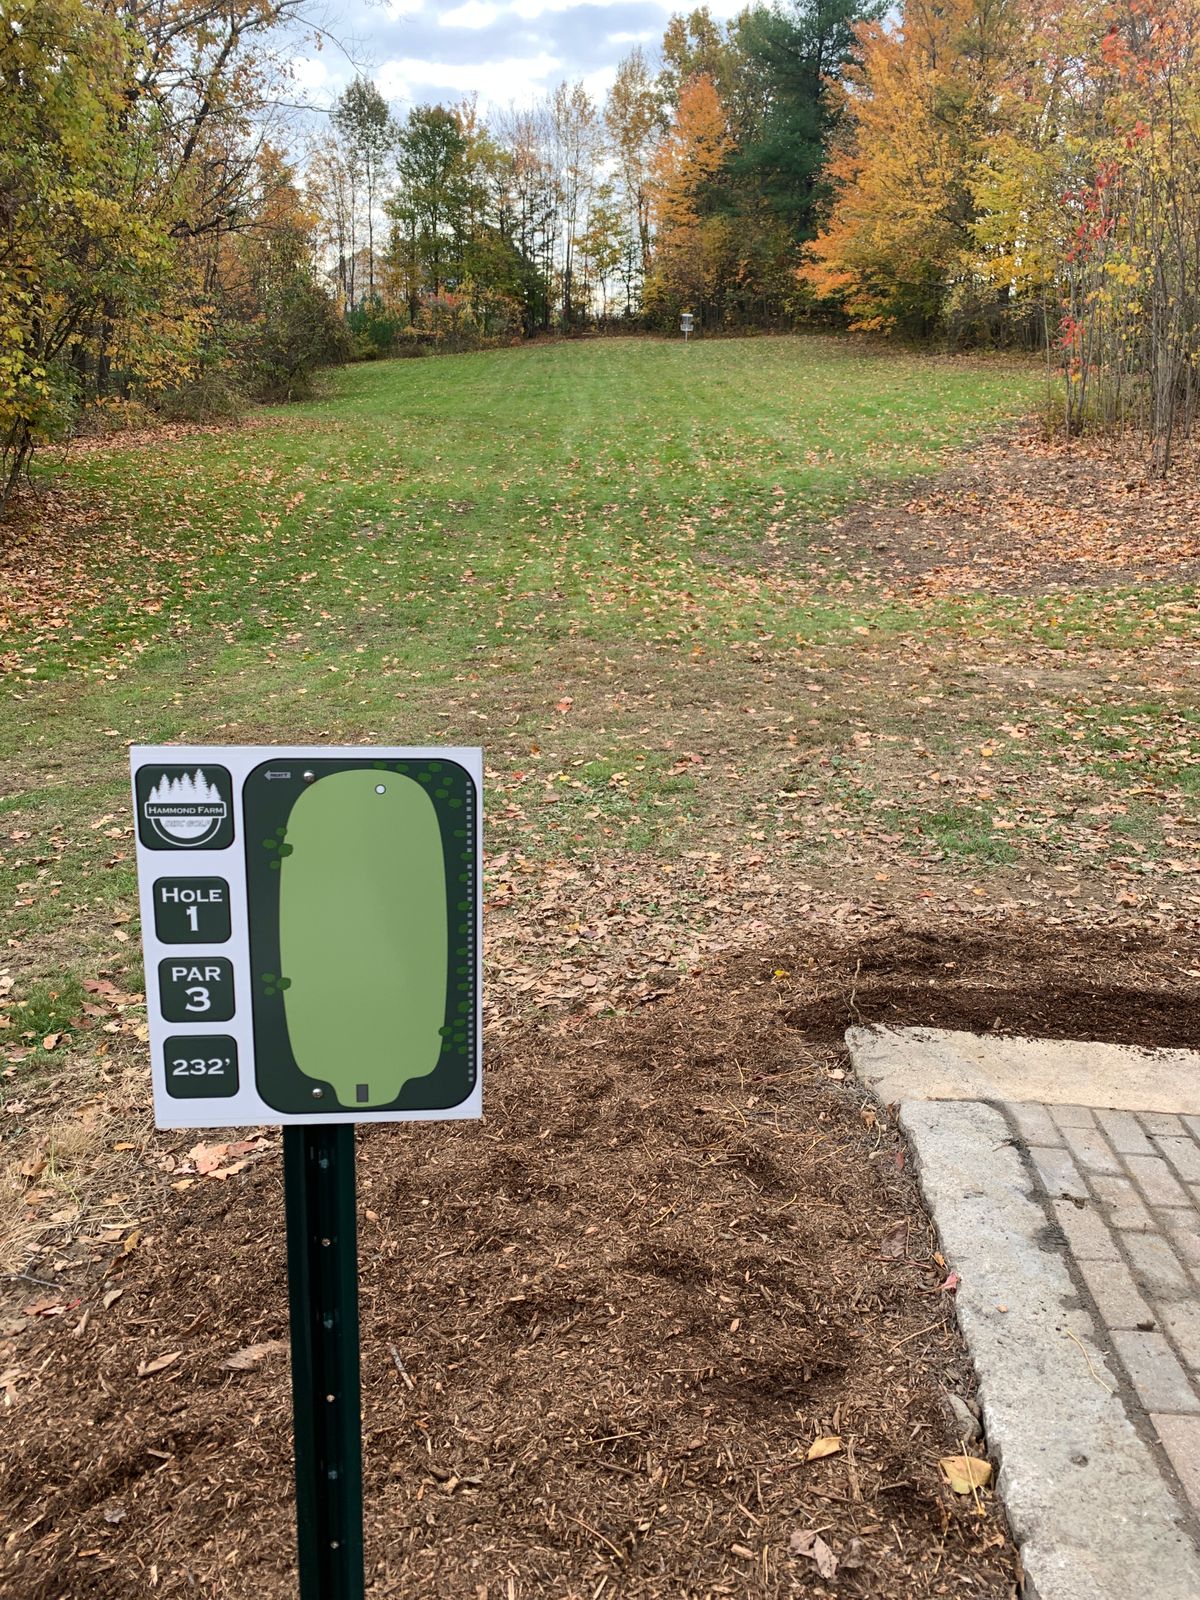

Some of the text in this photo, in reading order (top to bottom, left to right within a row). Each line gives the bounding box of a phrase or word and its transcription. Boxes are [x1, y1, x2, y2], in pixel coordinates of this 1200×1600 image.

[148, 806, 224, 815] HAMMOND FARM
[161, 887, 223, 903] HOLE
[186, 906, 199, 931] 1
[171, 966, 221, 982] PAR
[184, 986, 212, 1012] 3
[172, 1058, 231, 1076] 232'
